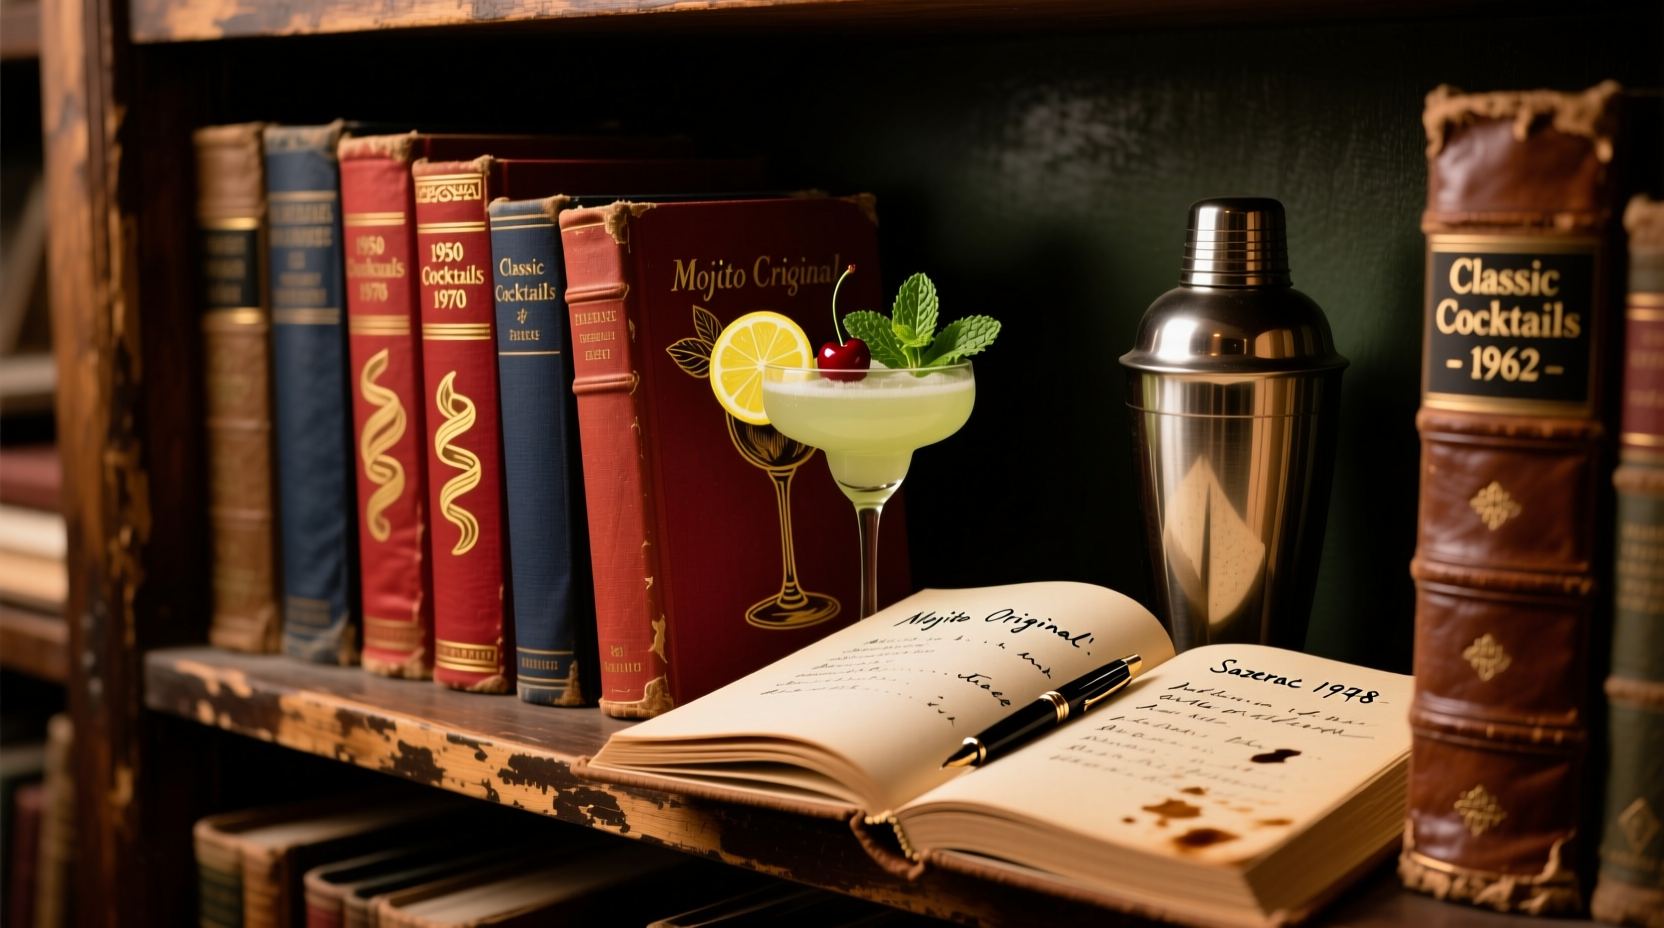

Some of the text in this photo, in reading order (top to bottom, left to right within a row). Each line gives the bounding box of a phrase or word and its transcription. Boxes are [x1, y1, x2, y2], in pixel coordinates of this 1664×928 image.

[430, 242, 464, 262] 1950
[422, 265, 484, 285] Cocktails
[499, 258, 545, 277] Classic
[671, 258, 746, 302] Mojito
[1449, 257, 1560, 297] Classic
[433, 289, 467, 309] 1970
[495, 282, 556, 302] Cocktails
[1436, 298, 1581, 338] Cocktails
[1470, 345, 1540, 382] 1962
[893, 611, 971, 631] Mojito
[985, 608, 1095, 656] Original!
[1209, 659, 1303, 689] Sazerac
